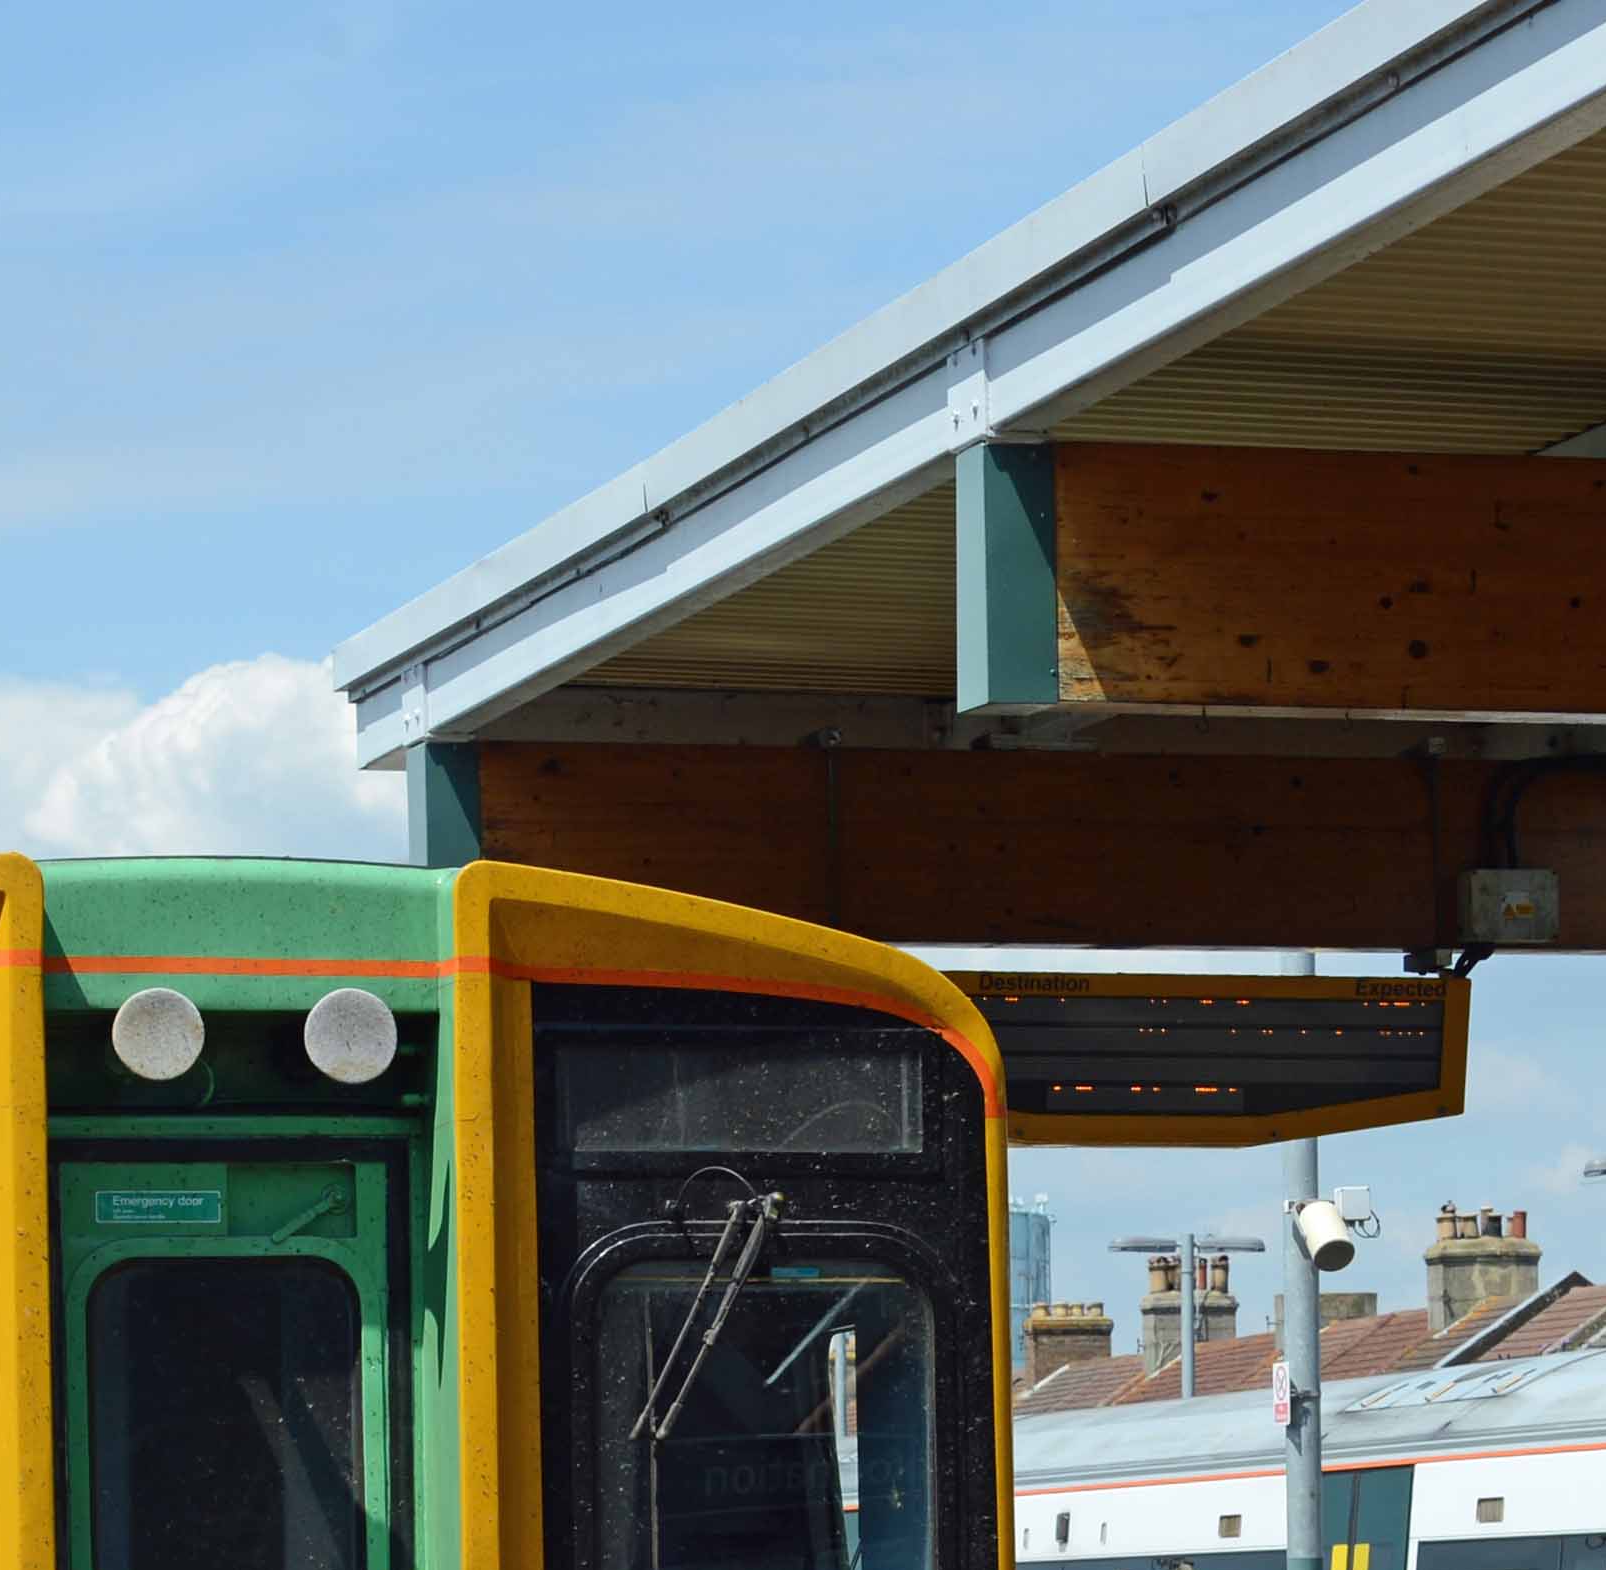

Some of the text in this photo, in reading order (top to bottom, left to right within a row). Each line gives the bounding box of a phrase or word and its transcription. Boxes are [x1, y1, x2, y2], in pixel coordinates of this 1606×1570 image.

[980, 974, 1447, 998] Destination Expected
[113, 1195, 203, 1208] Emergency door
